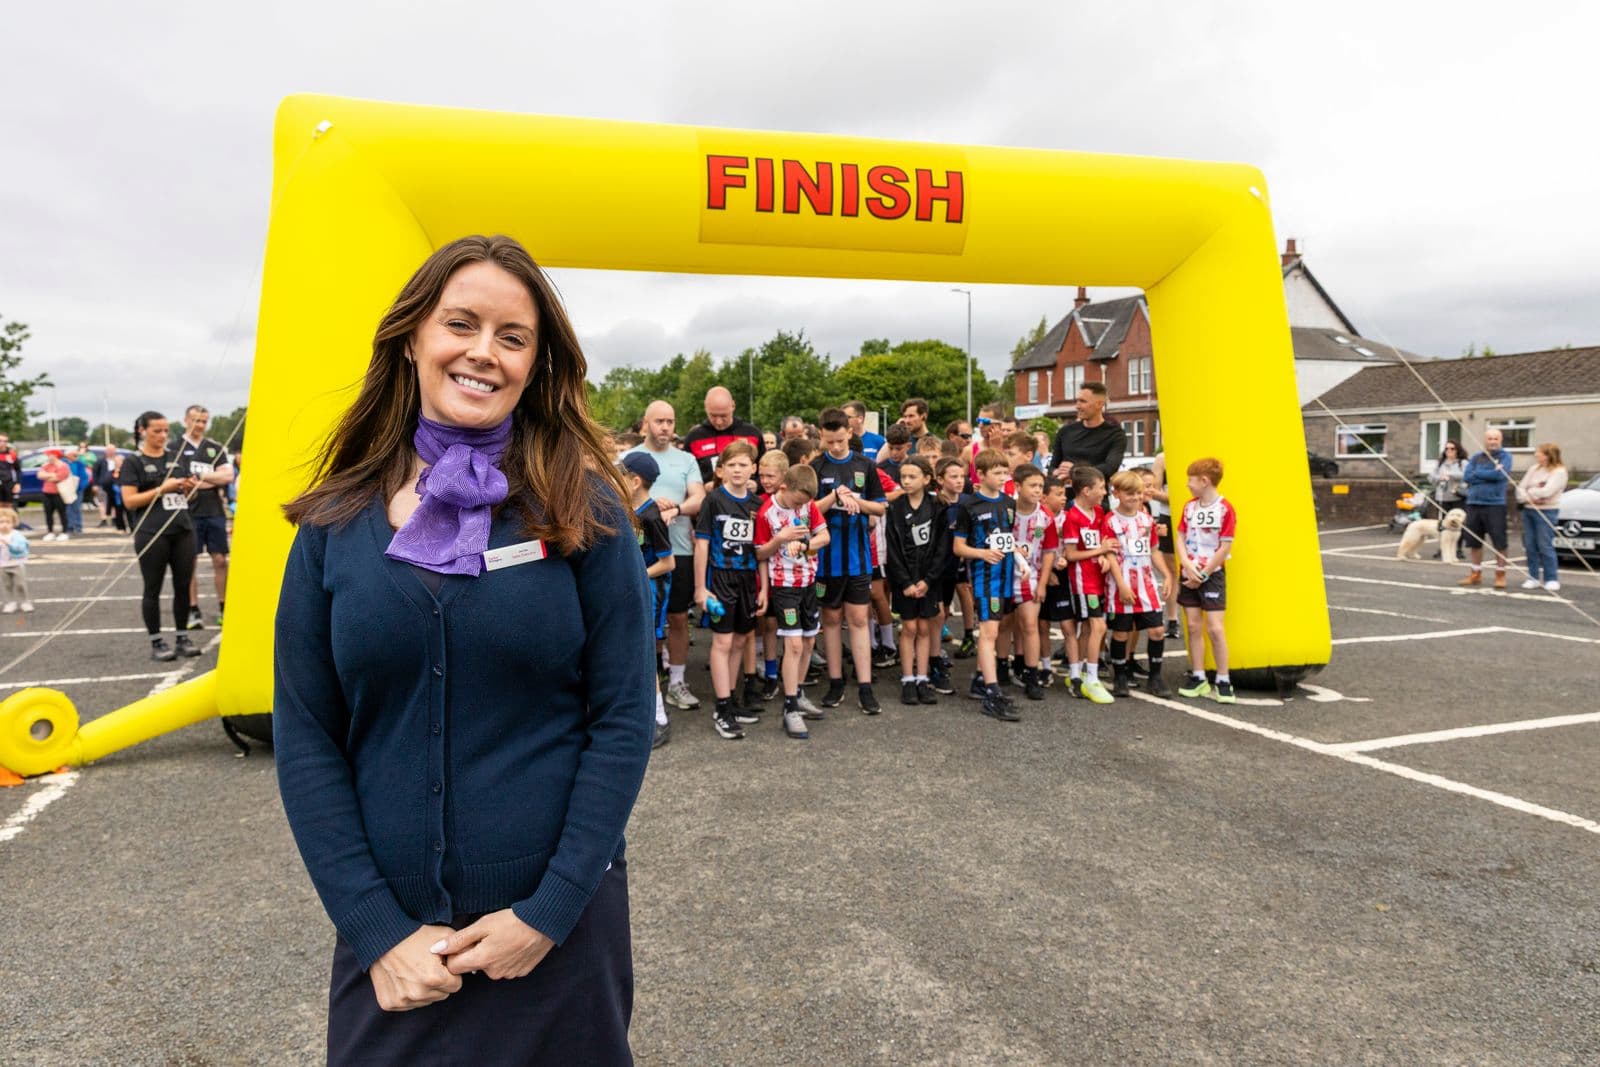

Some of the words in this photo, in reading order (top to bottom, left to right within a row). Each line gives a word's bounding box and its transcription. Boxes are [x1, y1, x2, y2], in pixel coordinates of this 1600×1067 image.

[706, 154, 964, 224] FINISH
[1197, 511, 1215, 526] 95
[730, 521, 749, 538] 83
[918, 527, 928, 541] 6
[996, 535, 1013, 550] 99
[1085, 532, 1098, 546] 81
